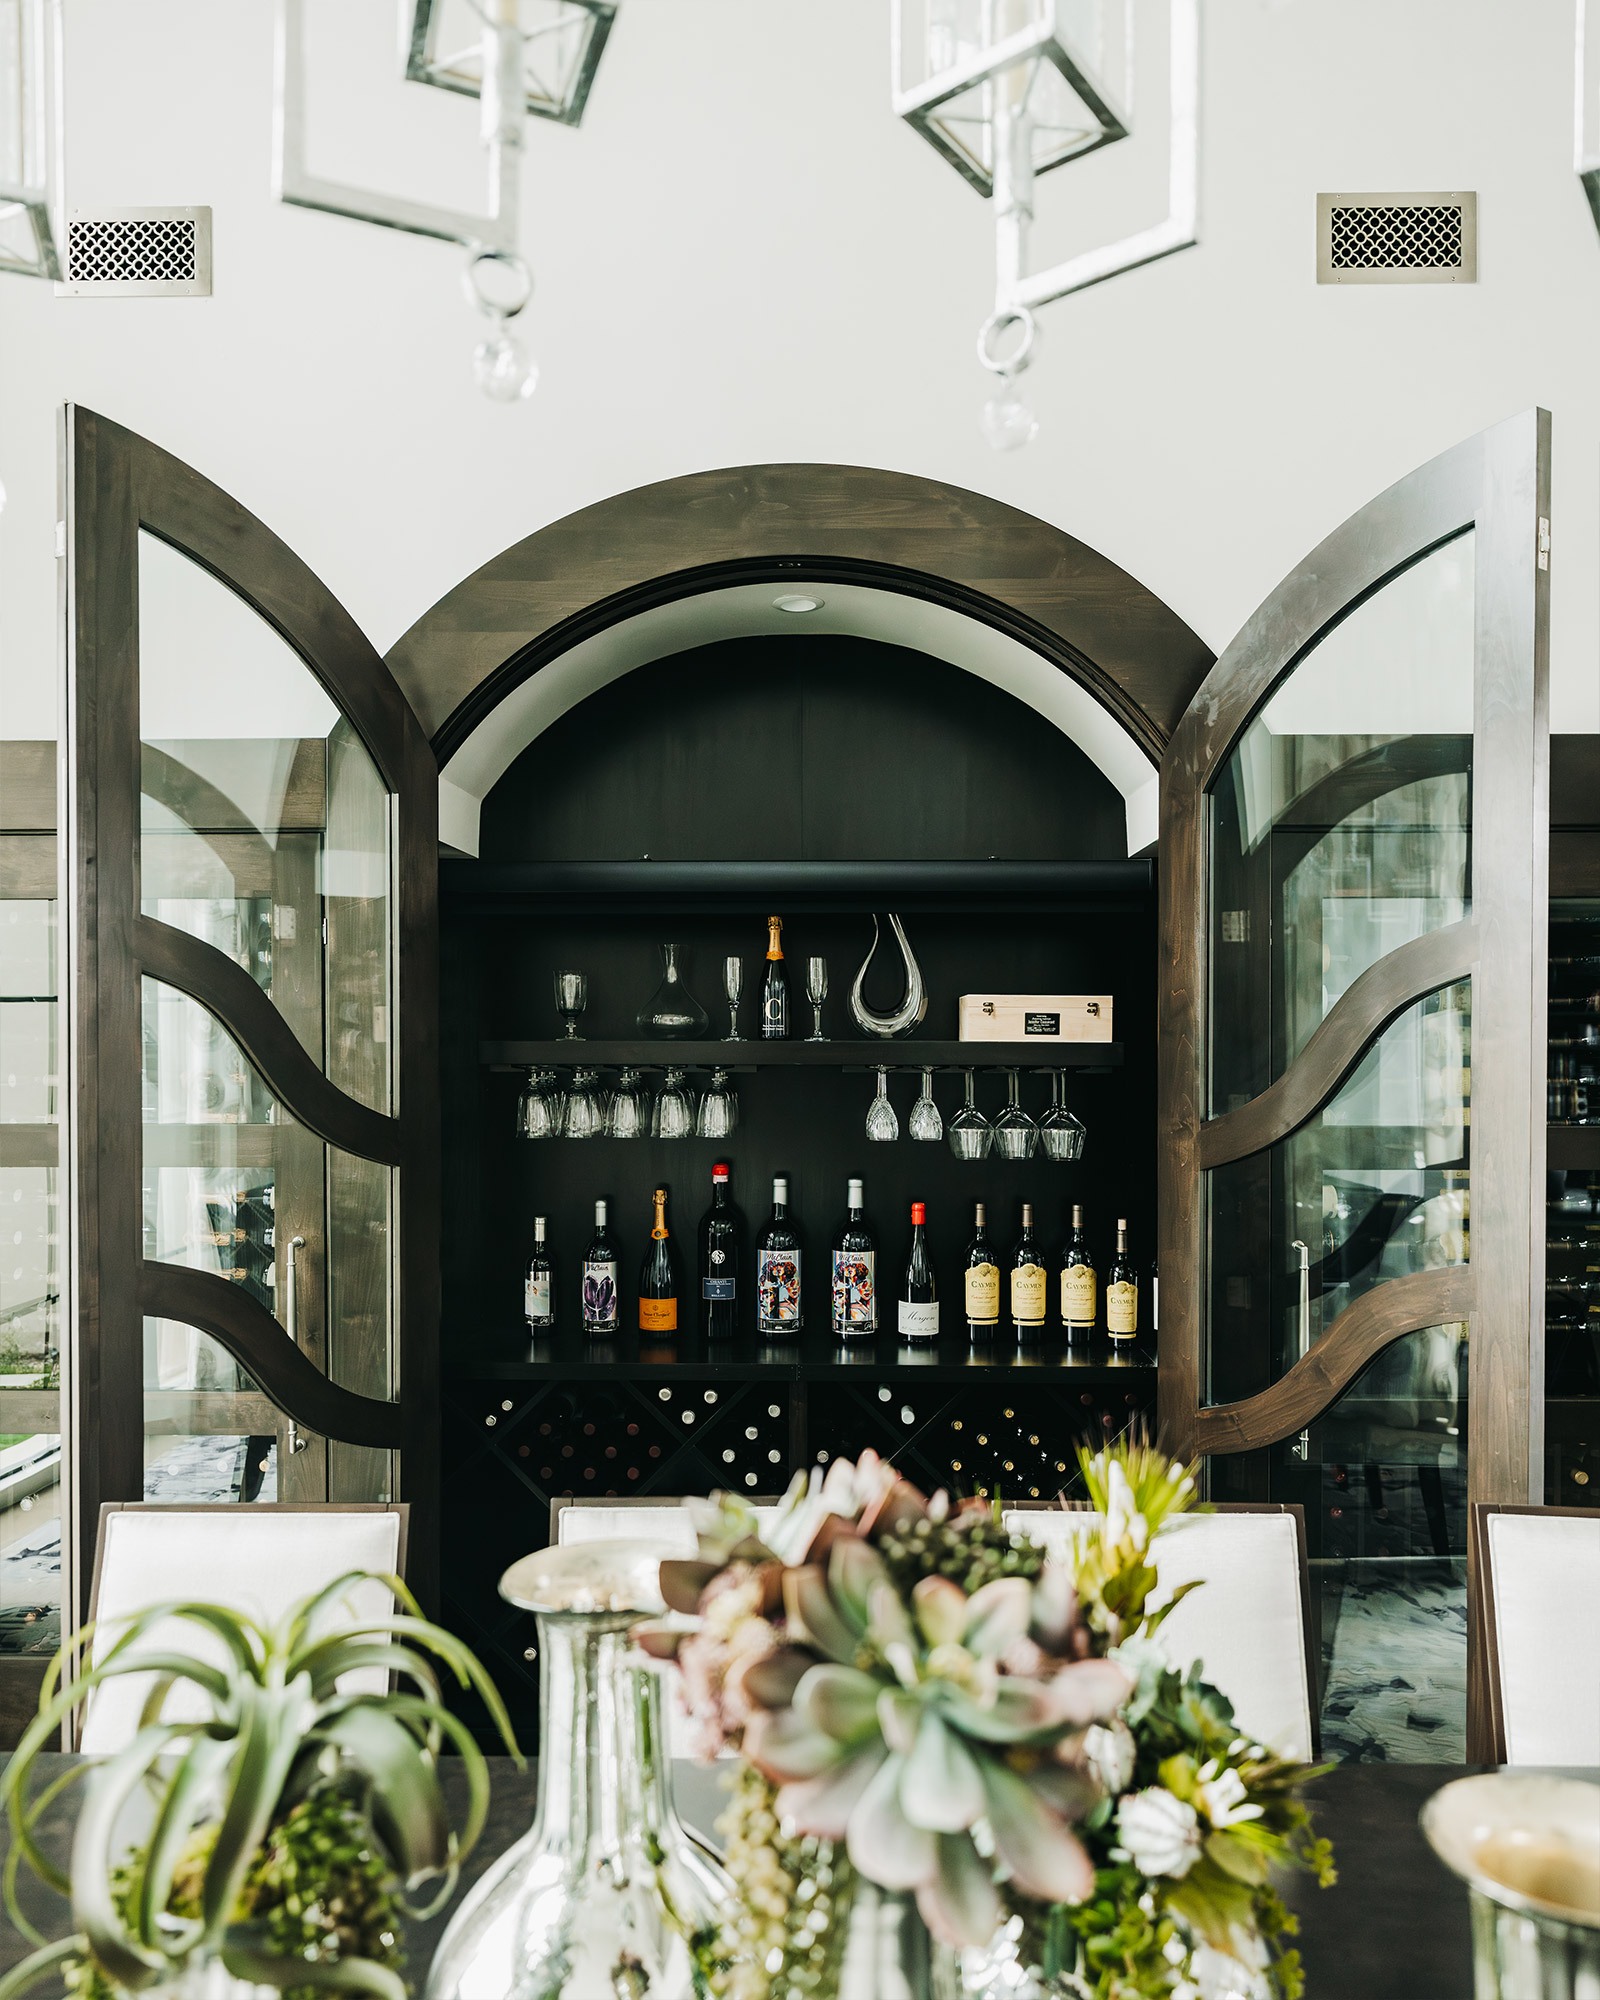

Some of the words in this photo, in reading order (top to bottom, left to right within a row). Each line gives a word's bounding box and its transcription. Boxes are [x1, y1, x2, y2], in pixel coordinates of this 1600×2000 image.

[971, 1280, 996, 1288] CAYMUS
[1016, 1281, 1042, 1289] CAYMUS
[1066, 1282, 1092, 1290] CAYMUS
